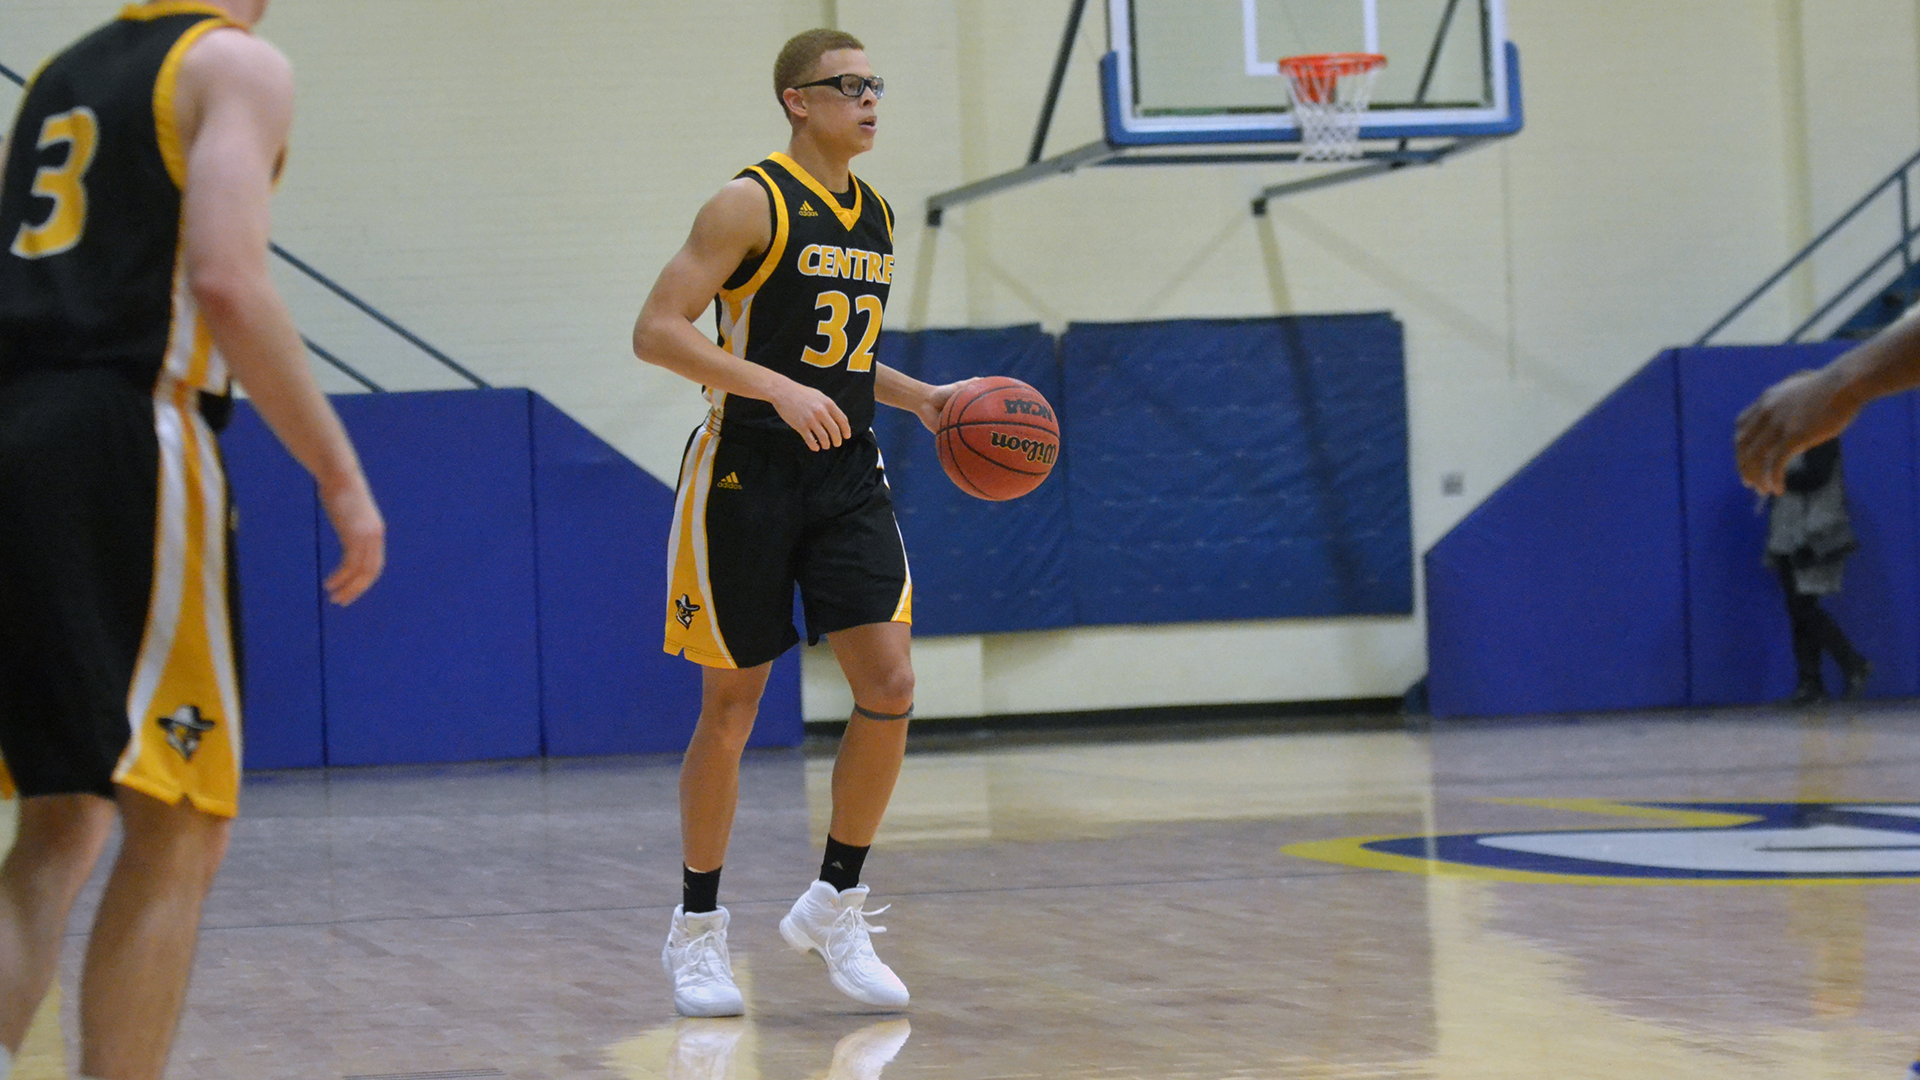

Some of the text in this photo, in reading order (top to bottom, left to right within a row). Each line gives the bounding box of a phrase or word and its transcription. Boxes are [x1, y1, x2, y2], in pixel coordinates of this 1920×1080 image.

[10, 105, 97, 259] 3
[798, 209, 819, 217] adidas
[797, 243, 895, 285] CENTRE
[801, 290, 883, 372] 32
[1004, 398, 1053, 422] NCAA
[991, 431, 1057, 464] Wilson
[716, 481, 743, 490] adidas
